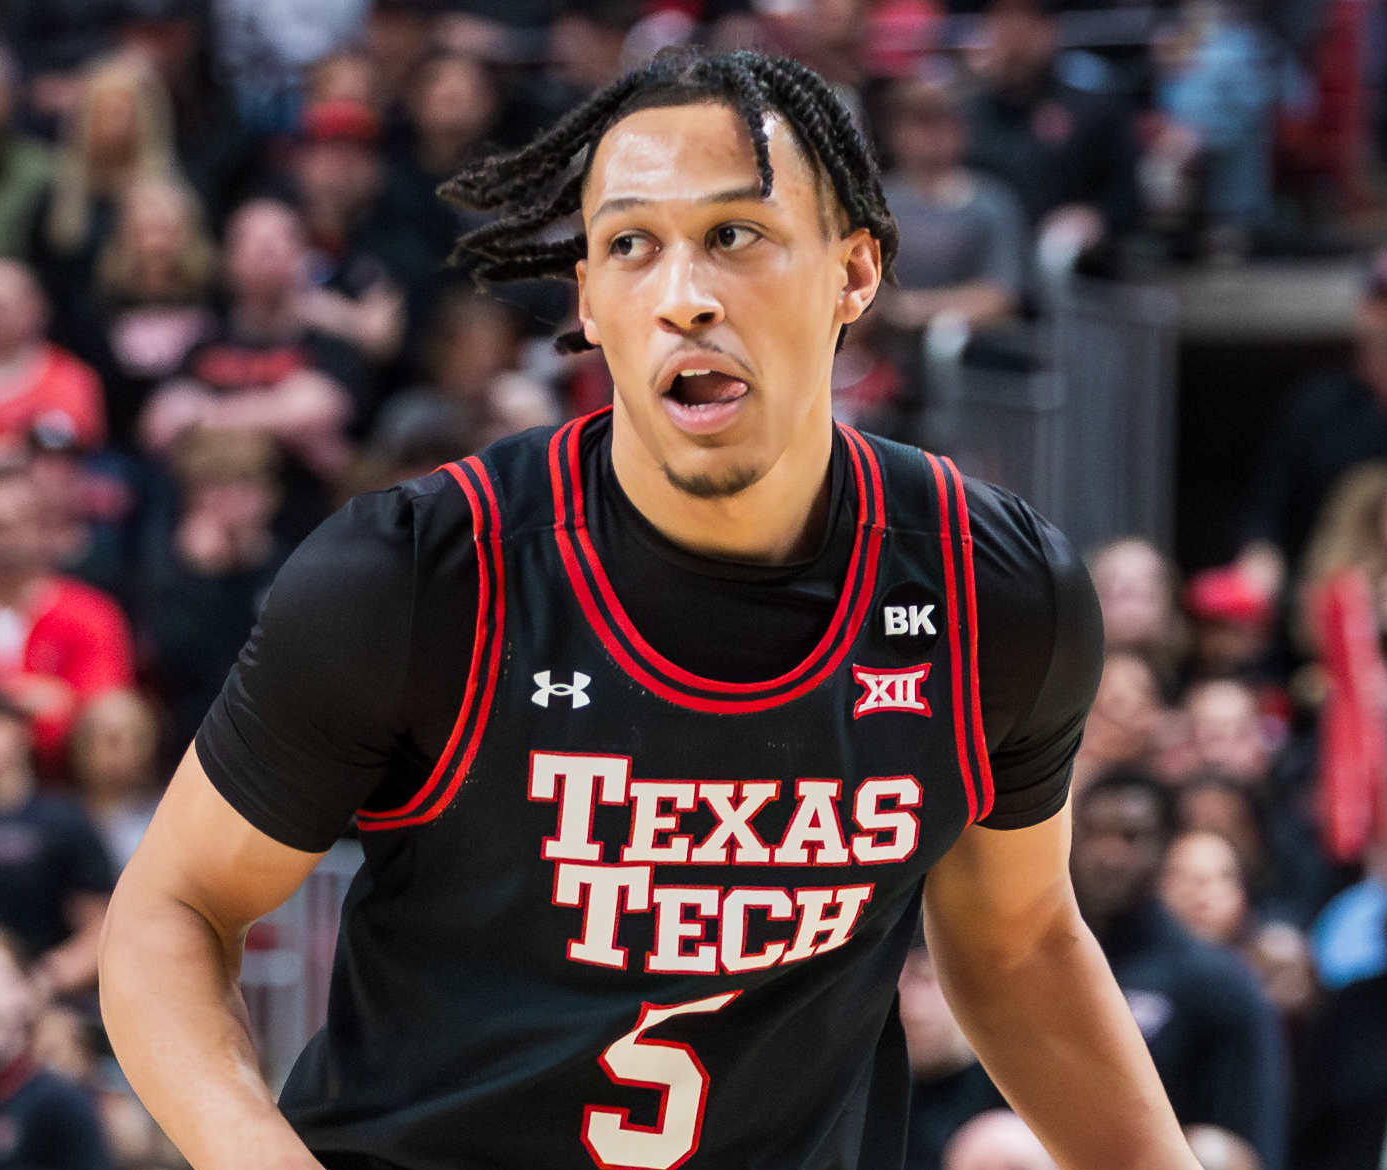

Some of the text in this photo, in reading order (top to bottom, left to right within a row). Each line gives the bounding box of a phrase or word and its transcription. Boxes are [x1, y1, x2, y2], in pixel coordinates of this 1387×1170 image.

[884, 604, 937, 636] BK
[855, 668, 927, 714] XII
[528, 750, 924, 867] TEXAS
[552, 860, 876, 976] TECH
